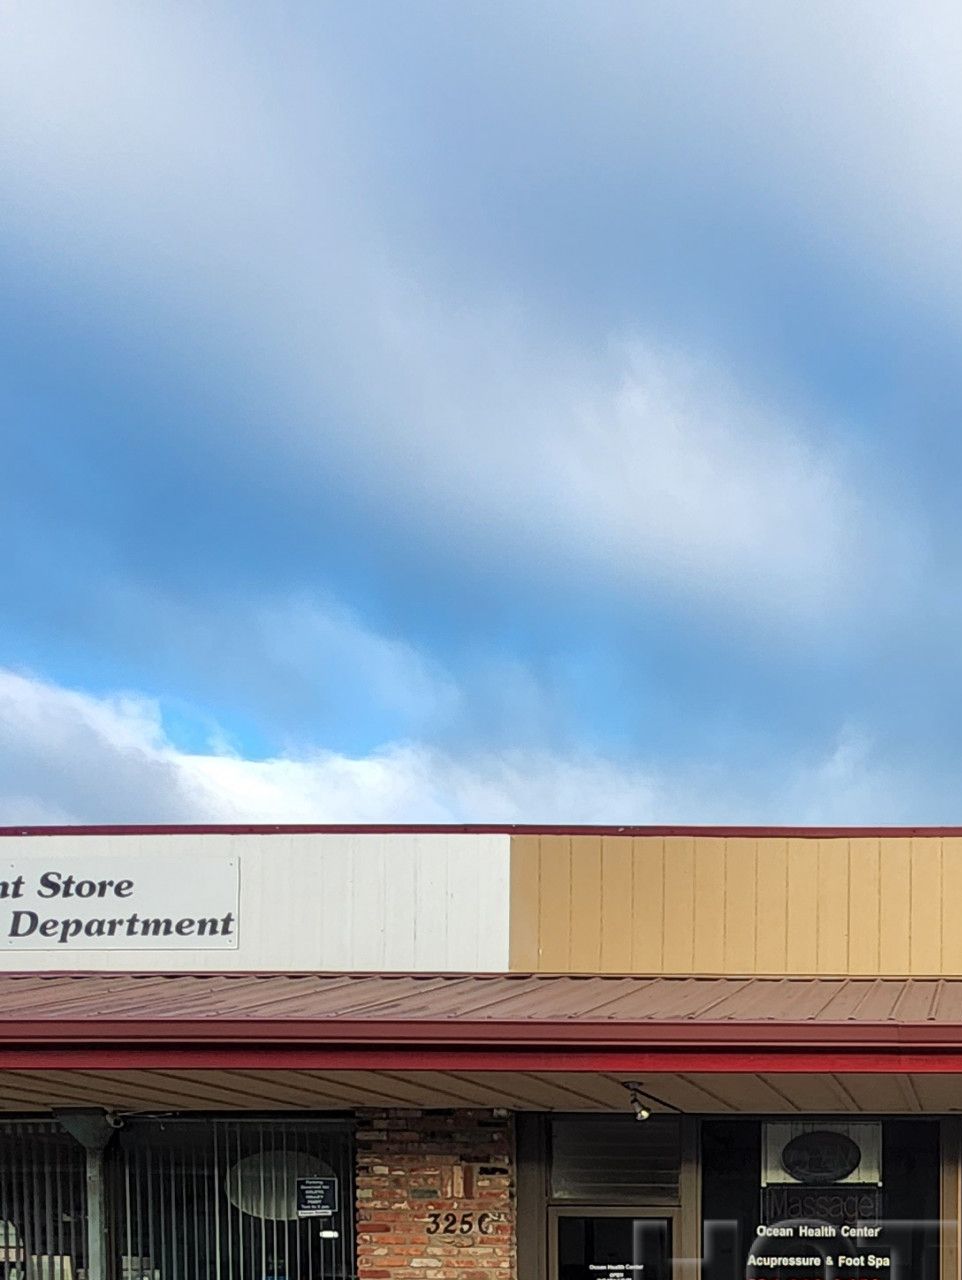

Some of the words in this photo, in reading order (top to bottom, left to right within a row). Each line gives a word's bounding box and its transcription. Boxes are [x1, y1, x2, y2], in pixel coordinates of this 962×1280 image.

[37, 871, 134, 899] Store
[8, 910, 235, 943] Department
[769, 1190, 875, 1225] Massage
[756, 1225, 793, 1237] Ocean
[799, 1225, 836, 1237] Health
[841, 1225, 880, 1237] Center
[747, 1255, 821, 1268] Acupressure
[825, 1256, 834, 1266] &
[838, 1255, 865, 1267] Foot
[867, 1255, 890, 1269] Spa
